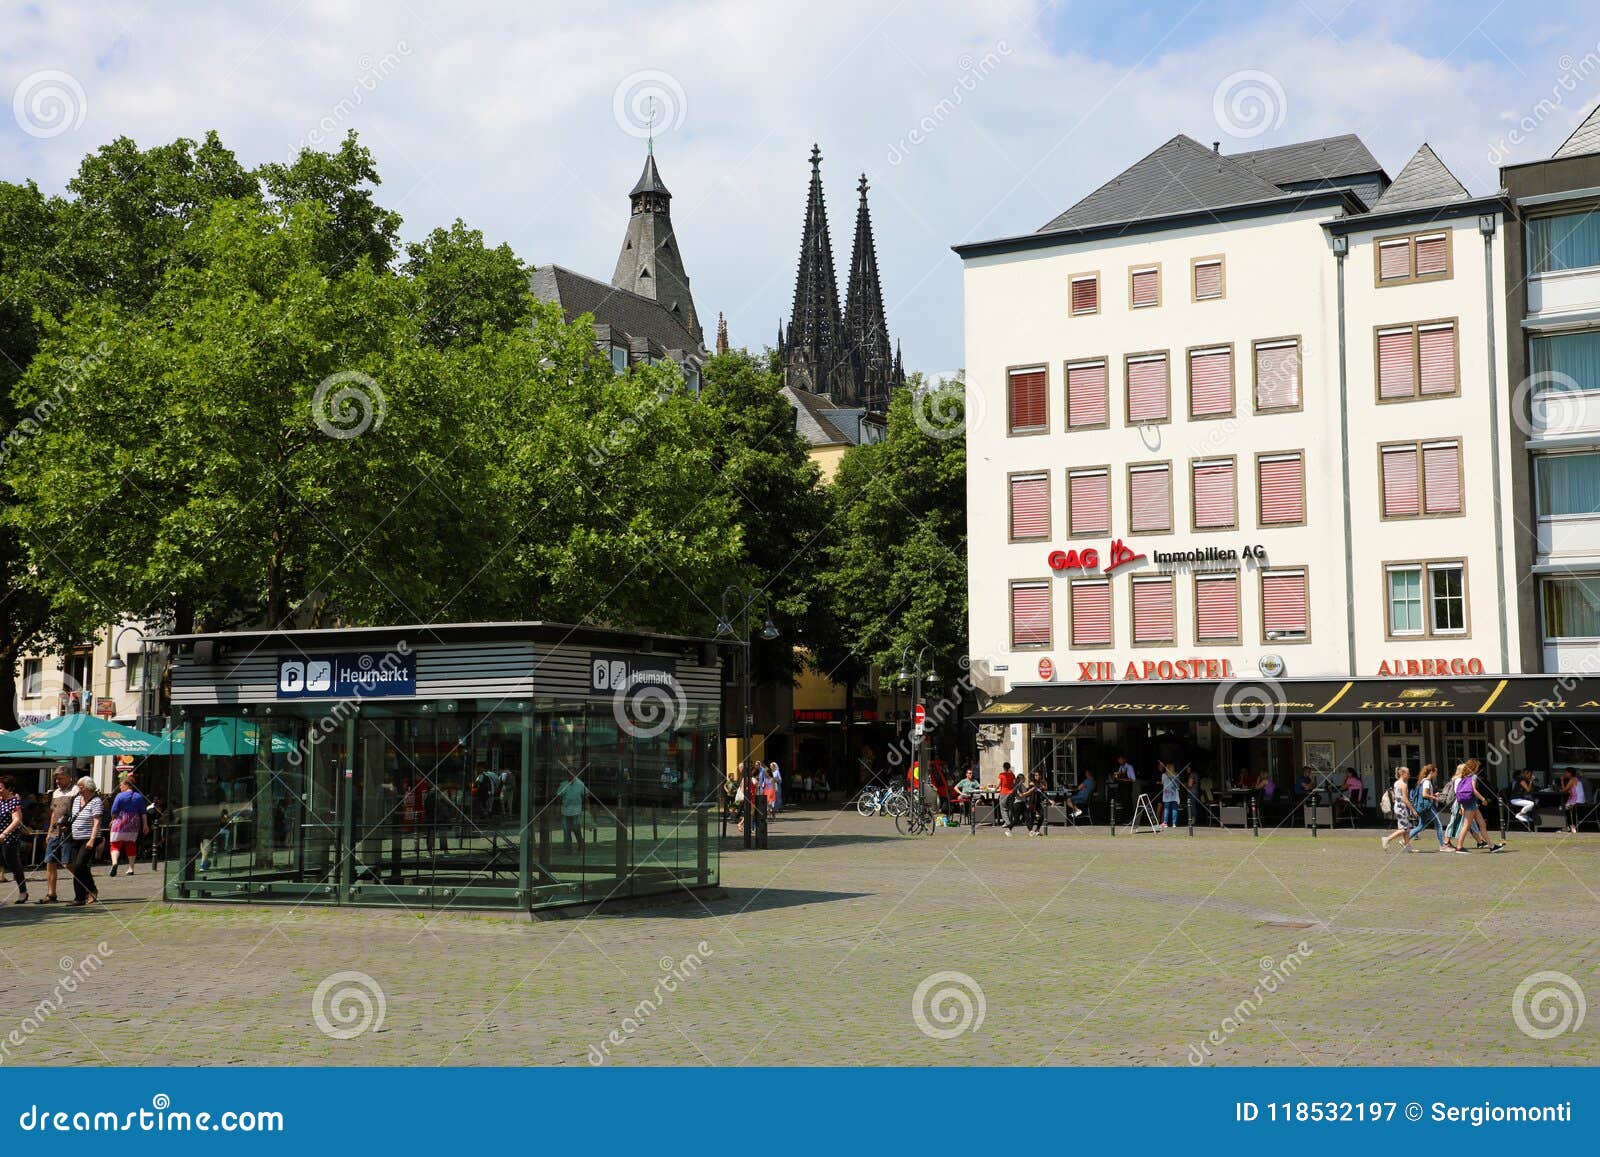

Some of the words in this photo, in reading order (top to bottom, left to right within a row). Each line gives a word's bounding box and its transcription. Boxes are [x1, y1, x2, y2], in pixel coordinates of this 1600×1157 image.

[1048, 548, 1098, 571] GAG
[1153, 548, 1236, 563] Immobilien
[1242, 545, 1265, 559] AG
[340, 667, 408, 683] Heumarkt
[1077, 662, 1111, 681] XII
[1123, 659, 1236, 680] APOSTEL
[1378, 658, 1483, 676] ALBERGO
[632, 669, 672, 685] Heumarkt
[1079, 703, 1191, 712] APOSTEL
[1358, 701, 1456, 709] HOTEL
